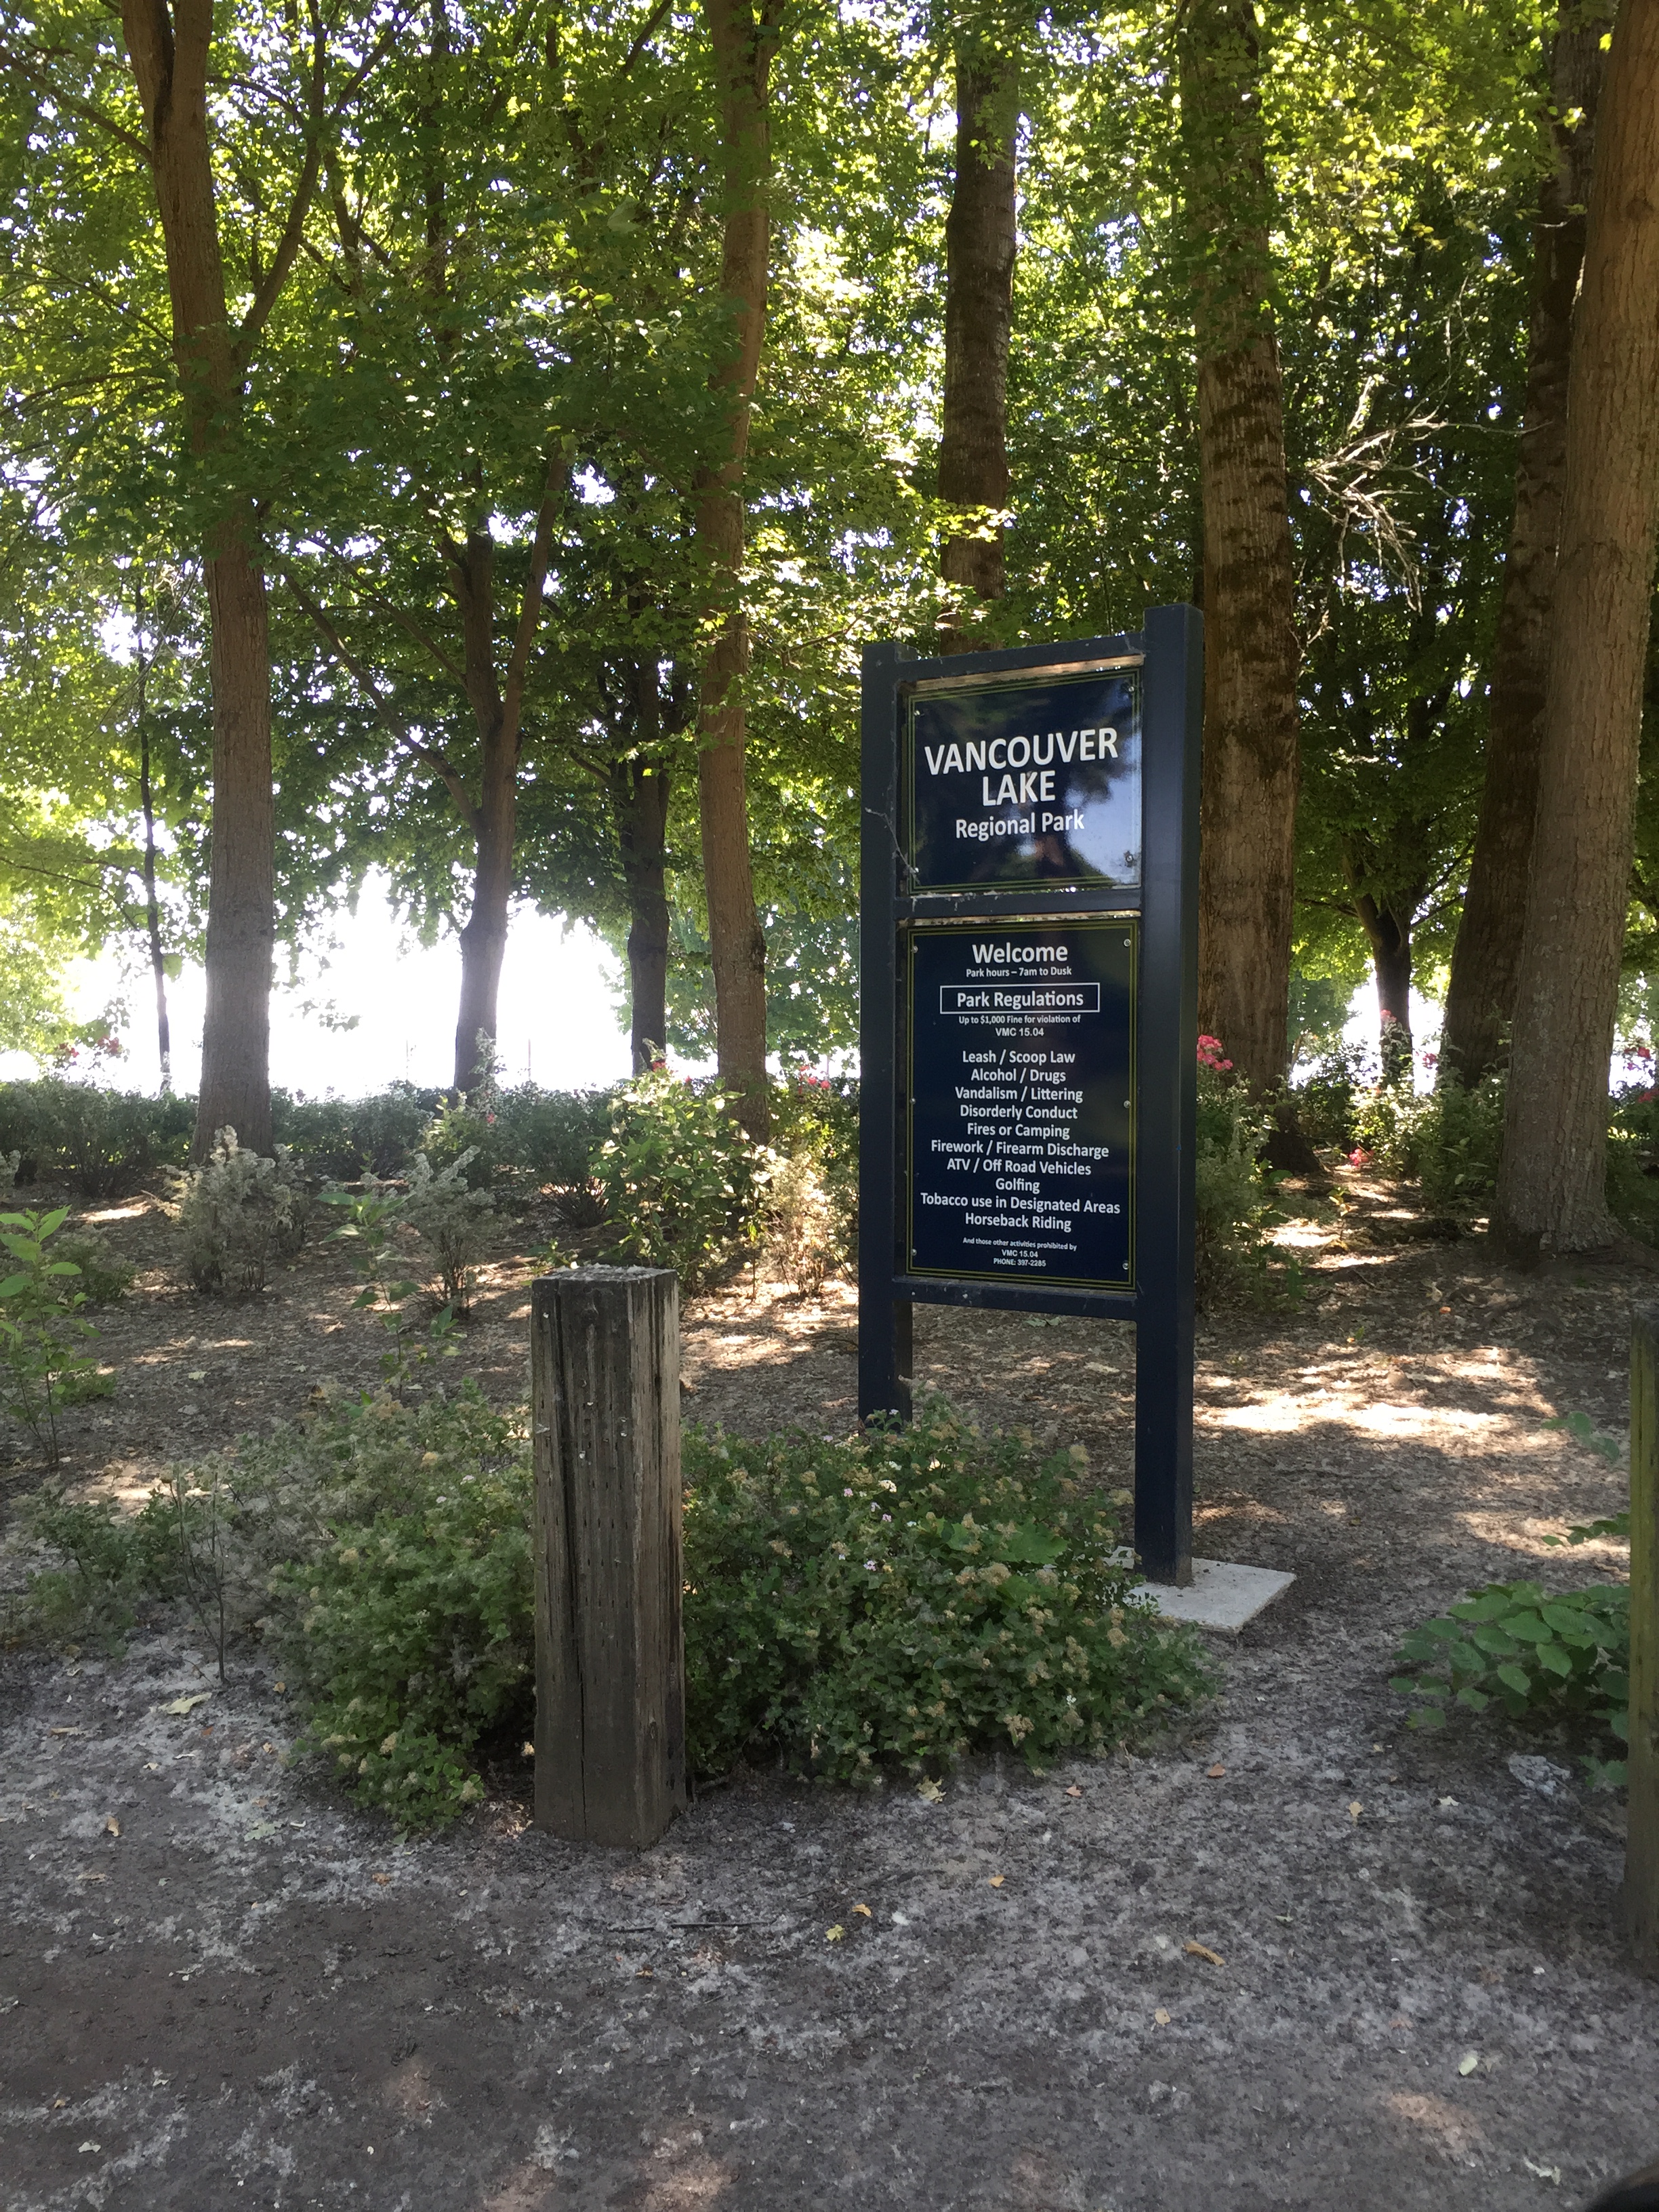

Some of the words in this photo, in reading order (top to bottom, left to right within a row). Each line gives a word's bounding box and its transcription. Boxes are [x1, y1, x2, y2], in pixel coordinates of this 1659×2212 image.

[924, 727, 1118, 775] VANCOUVER
[982, 771, 1057, 806] LAKE
[956, 812, 1036, 842] Regional
[1042, 809, 1085, 832] Park
[972, 942, 1068, 964] Welcome
[966, 968, 985, 977] Park
[986, 968, 1010, 977] hours
[1019, 968, 1037, 976] 7am
[1039, 968, 1048, 976] to
[1050, 966, 1072, 976] Dusk
[958, 992, 989, 1007] Park
[994, 991, 1084, 1010] Regulations
[959, 1016, 969, 1025] Up
[971, 1016, 979, 1024] to
[980, 1015, 1005, 1025] $1,000
[1007, 1015, 1023, 1023] Fine
[1024, 1015, 1036, 1023] for
[1037, 1015, 1070, 1023] violation
[996, 1028, 1017, 1037] VMC
[1019, 1027, 1044, 1036] 15.04
[962, 1050, 996, 1063] Leash
[1009, 1050, 1046, 1065] Scoop
[1050, 1050, 1076, 1063] Law
[971, 1068, 1017, 1082] Alcohol
[1030, 1069, 1066, 1084] Drugs
[956, 1086, 1017, 1100] Vandalism
[1031, 1087, 1083, 1103] Littering
[960, 1105, 1022, 1120] Disorderly
[1025, 1105, 1078, 1119] Conduct
[967, 1122, 996, 1135] Fires
[998, 1126, 1012, 1135] or
[1015, 1124, 1070, 1140] Camping
[931, 1140, 983, 1153] Firework
[996, 1141, 1044, 1155] Firearm
[1048, 1143, 1109, 1160] Discharge
[947, 1158, 970, 1171] ATV
[983, 1159, 1002, 1172] Off
[1005, 1160, 1036, 1173] Road
[1040, 1161, 1091, 1175] Vehicles
[996, 1177, 1040, 1194] Golfing
[920, 1192, 968, 1206] Tobacco
[972, 1197, 992, 1207] use
[996, 1195, 1006, 1208] in
[1011, 1196, 1080, 1212] Designated
[1084, 1200, 1120, 1214] Areas
[966, 1212, 1029, 1228] Horseback
[1032, 1216, 1071, 1233] Riding
[1002, 1249, 1018, 1257] VMC
[1019, 1250, 1038, 1258] 15.04
[1037, 1242, 1068, 1250] prohibited
[1069, 1243, 1077, 1251] by
[1017, 1258, 1046, 1267] 397-2285
